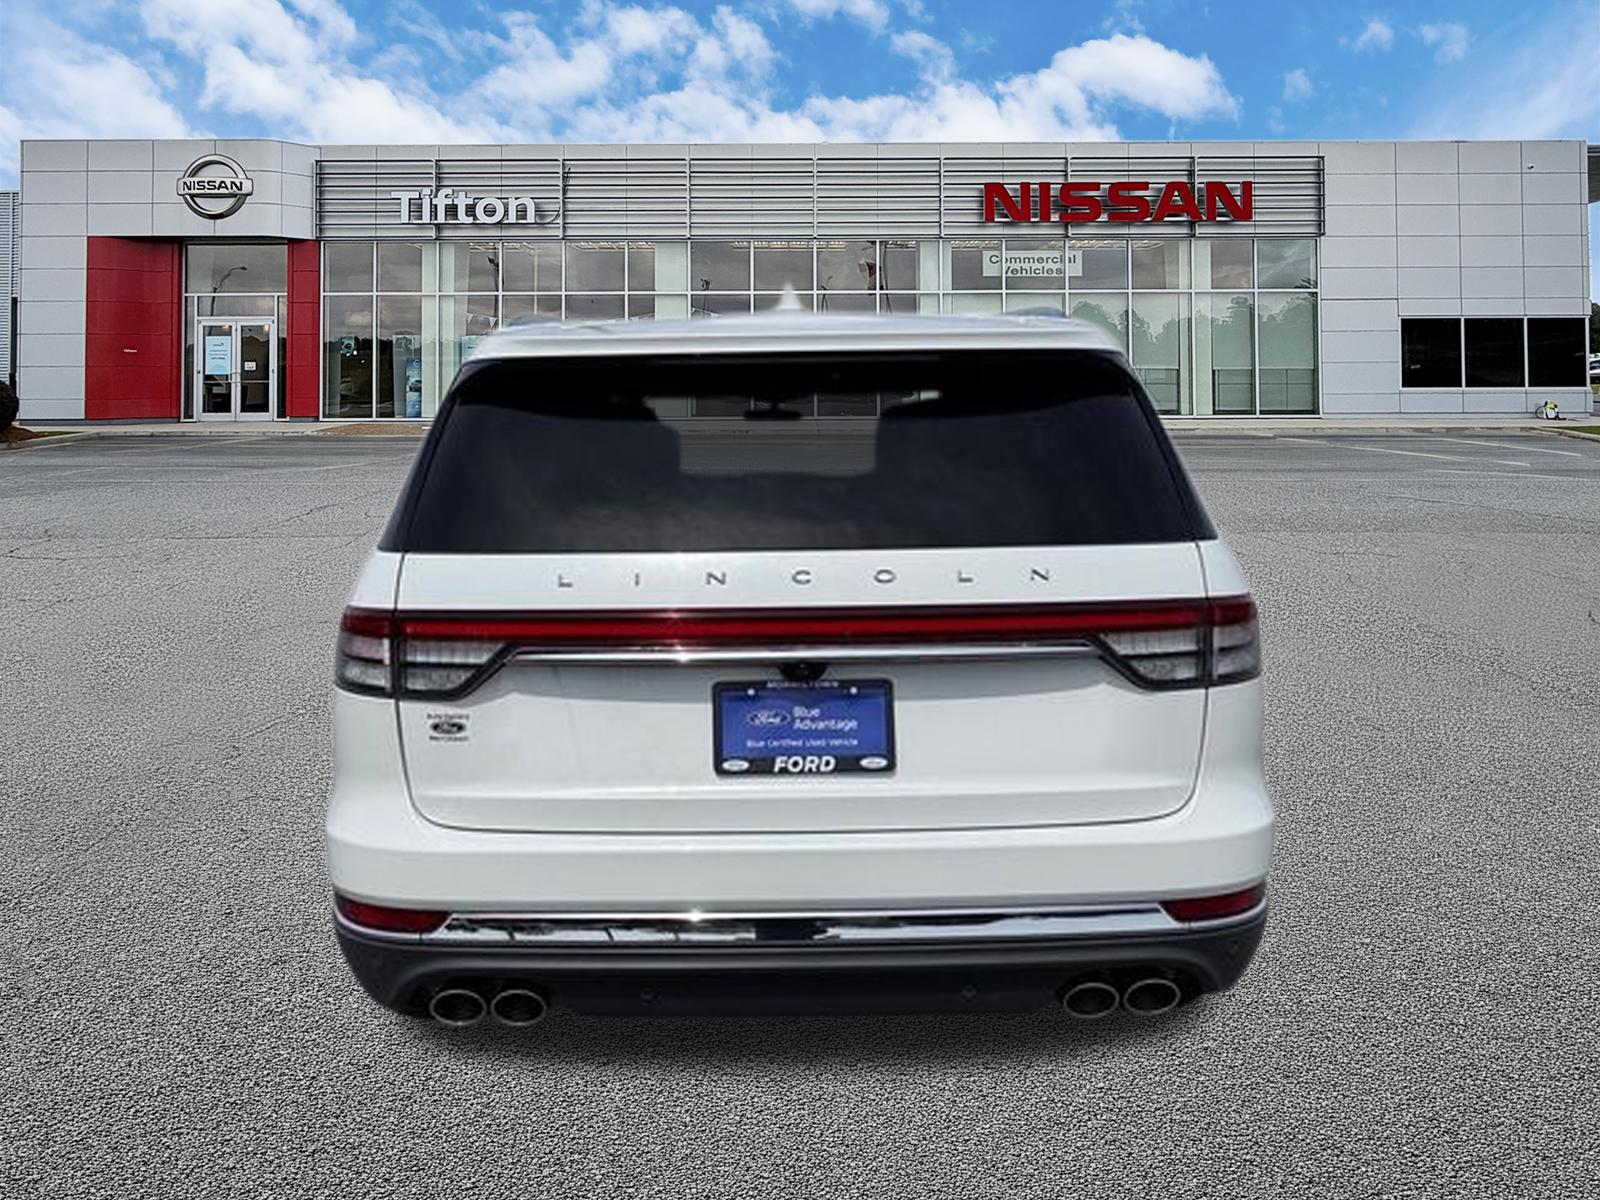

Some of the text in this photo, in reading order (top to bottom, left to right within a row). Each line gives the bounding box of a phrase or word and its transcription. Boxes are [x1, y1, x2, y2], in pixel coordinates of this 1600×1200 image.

[182, 180, 243, 192] NISSAN
[391, 187, 536, 224] Tifton
[983, 180, 1253, 221] NISSAN
[557, 567, 1051, 588] LINCOLN
[792, 706, 821, 718] Blue
[792, 718, 859, 731] Advantage
[773, 755, 836, 773] FORD
